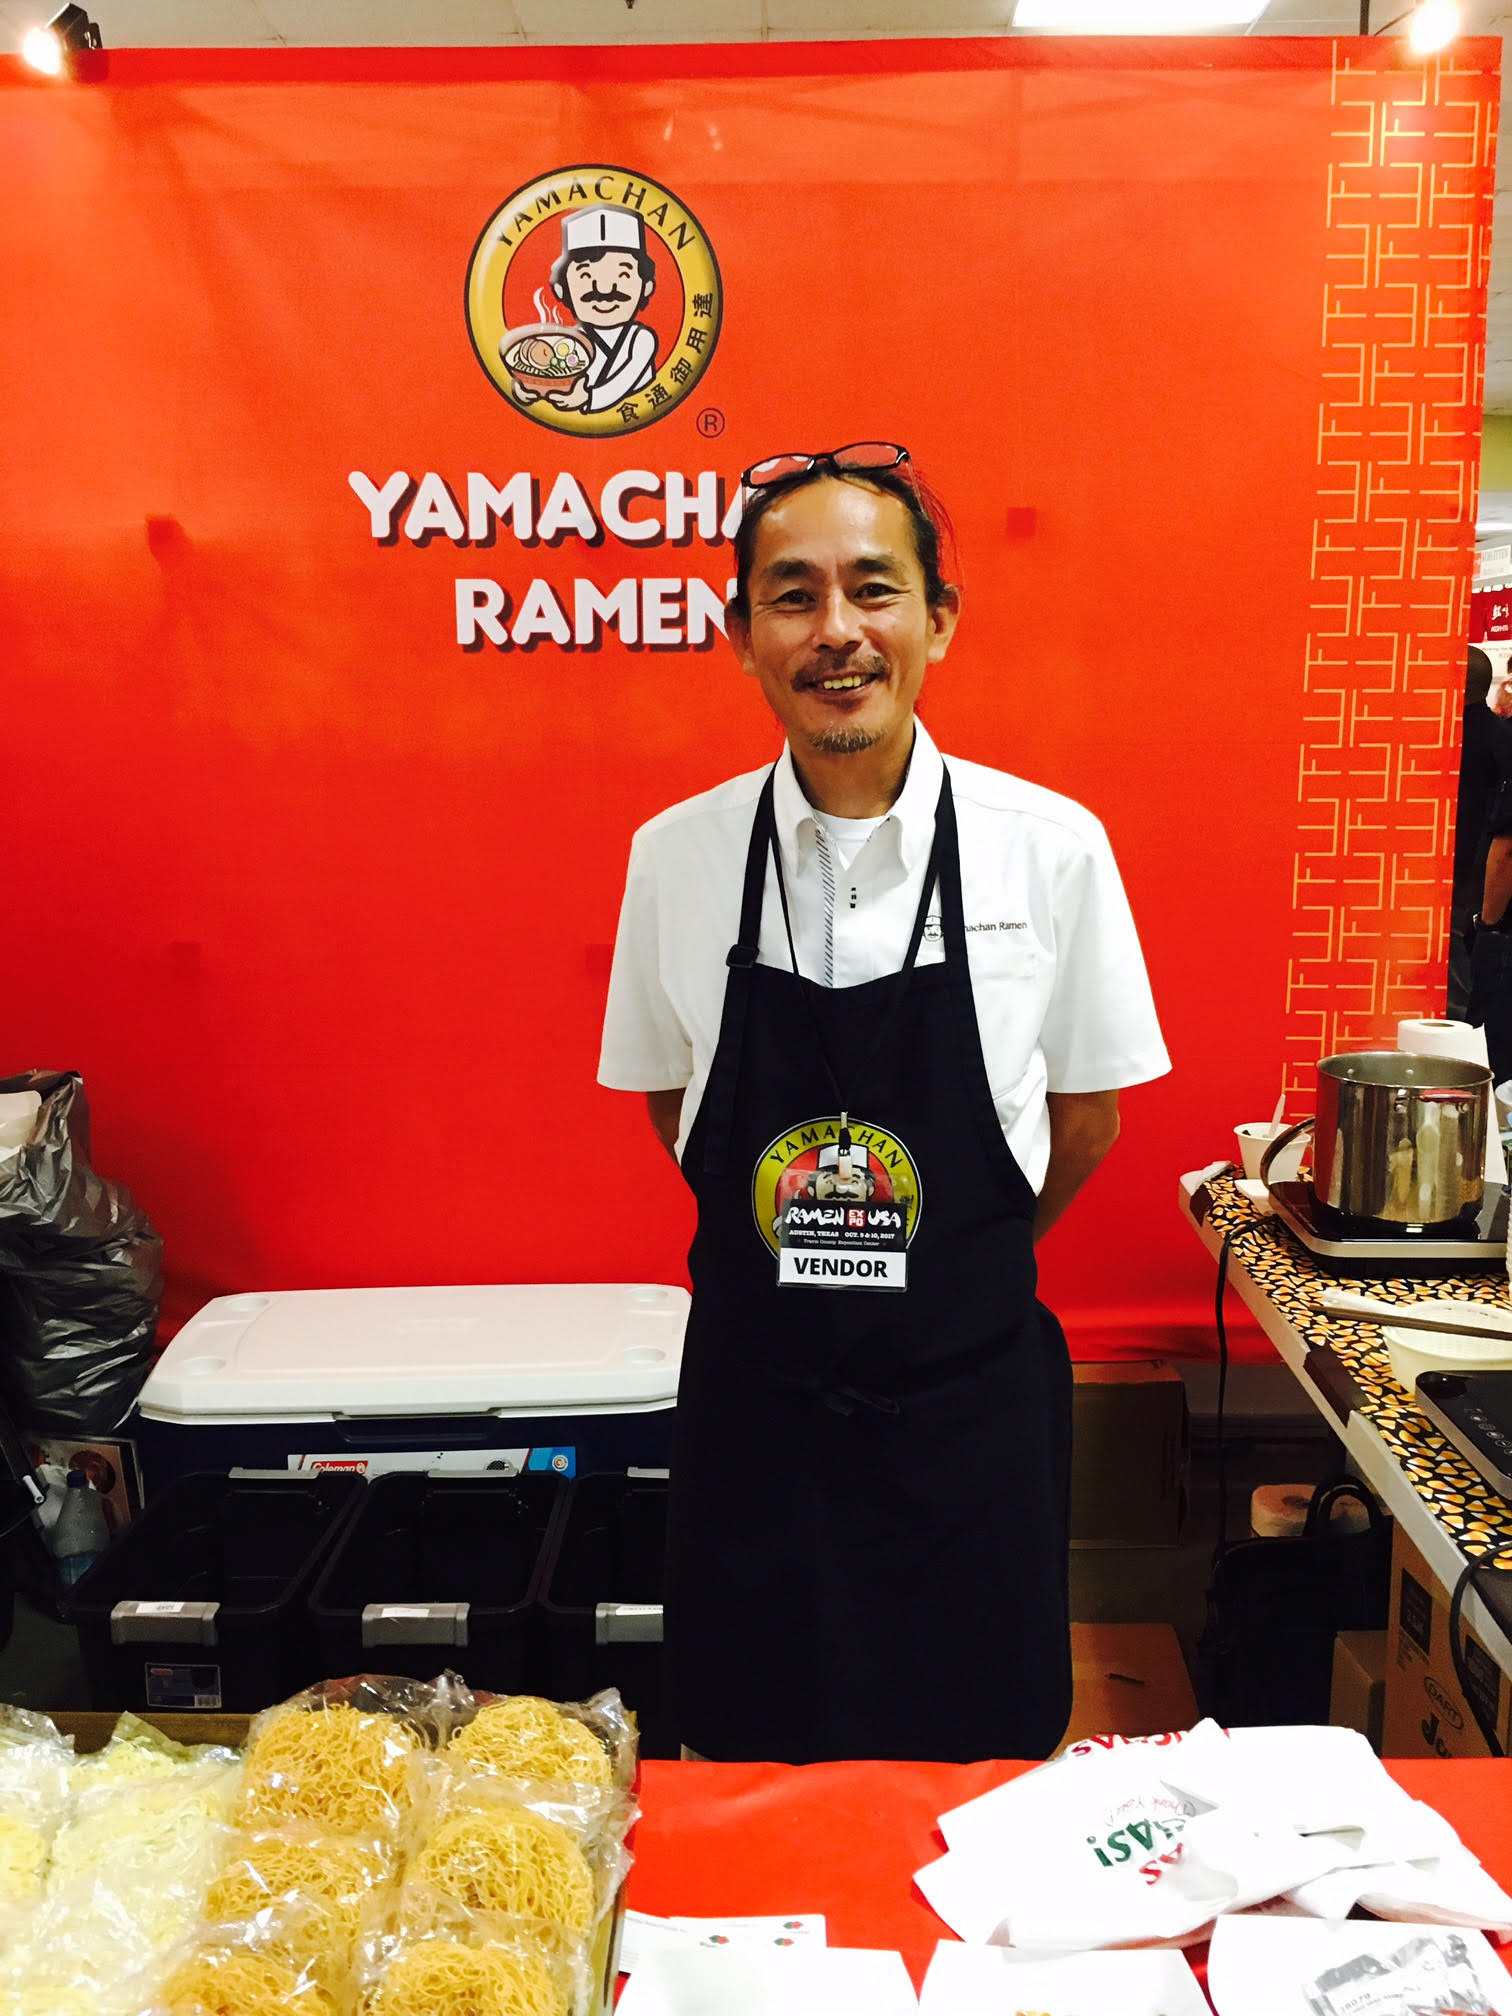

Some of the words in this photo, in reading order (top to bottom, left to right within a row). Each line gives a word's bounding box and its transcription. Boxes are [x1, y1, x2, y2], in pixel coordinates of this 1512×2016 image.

[496, 175, 697, 252] YAMACHAN
[348, 470, 744, 546] YAMACH
[455, 577, 739, 650] RAMEN
[999, 921, 1027, 931] Ramen
[770, 1124, 903, 1169] YAMAHAN
[785, 1207, 844, 1226] RAMEN
[867, 1209, 901, 1228] USA
[789, 1229, 816, 1237] AUSTIN,
[794, 1257, 888, 1278] VENDOR
